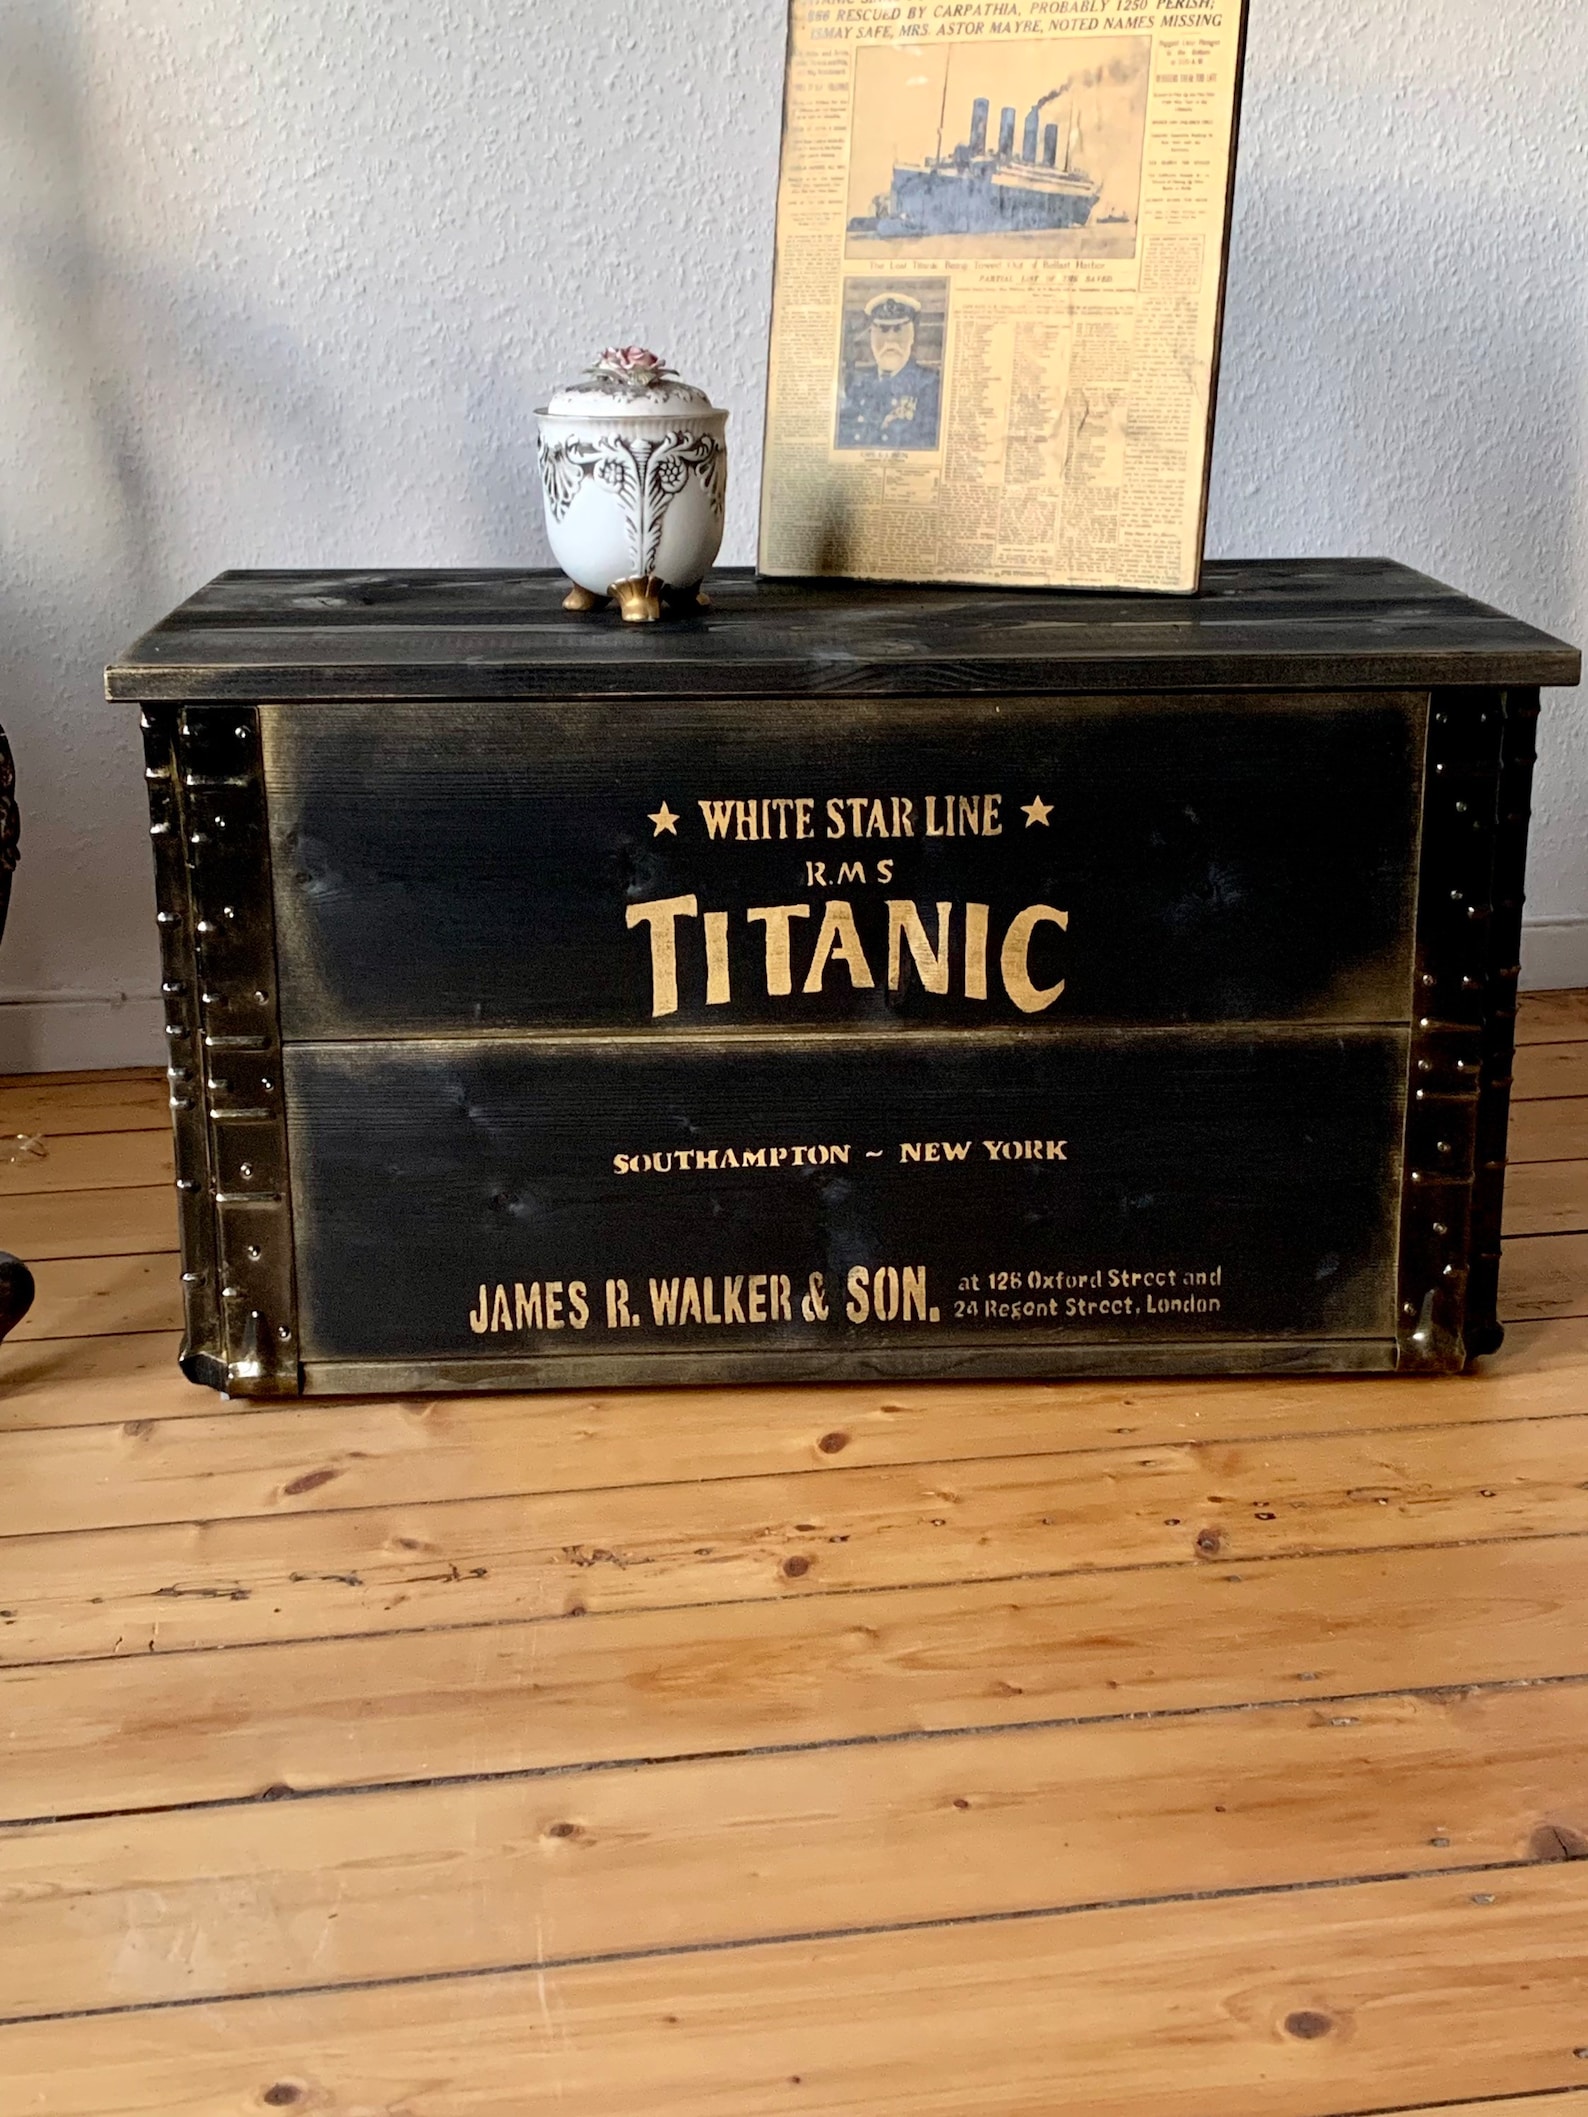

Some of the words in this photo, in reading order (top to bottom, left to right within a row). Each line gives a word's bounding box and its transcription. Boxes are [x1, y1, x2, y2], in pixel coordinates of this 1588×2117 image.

[836, 7, 901, 22] RESCUED
[907, 6, 927, 20] BY
[933, 3, 1021, 18] CARPATHIA,
[1030, 1, 1107, 15] PROBABLY
[1116, 0, 1147, 11] 1250
[856, 25, 894, 39] SAFE,
[935, 21, 984, 36] ASTOR
[1048, 18, 1099, 32] NOTED
[1104, 16, 1155, 30] NAMES
[1160, 14, 1223, 28] MISSING
[697, 797, 815, 841] WHITE
[826, 796, 915, 839] STAR
[924, 793, 1003, 838] LINE
[624, 893, 1069, 1018] TITANIC
[612, 1144, 852, 1175] SOUTHAMPTON
[899, 1141, 973, 1163] NEW
[982, 1139, 1068, 1161] YORK
[958, 1274, 980, 1291] at
[1027, 1268, 1102, 1290] Oxford
[1108, 1268, 1176, 1288] Street
[1183, 1265, 1222, 1286] and
[469, 1280, 590, 1334] JAMES
[605, 1278, 641, 1329] R.
[648, 1274, 792, 1326] WALKER
[801, 1271, 830, 1323] &
[845, 1265, 941, 1325] SON.
[954, 1300, 979, 1318] 24
[1146, 1293, 1221, 1314] London
